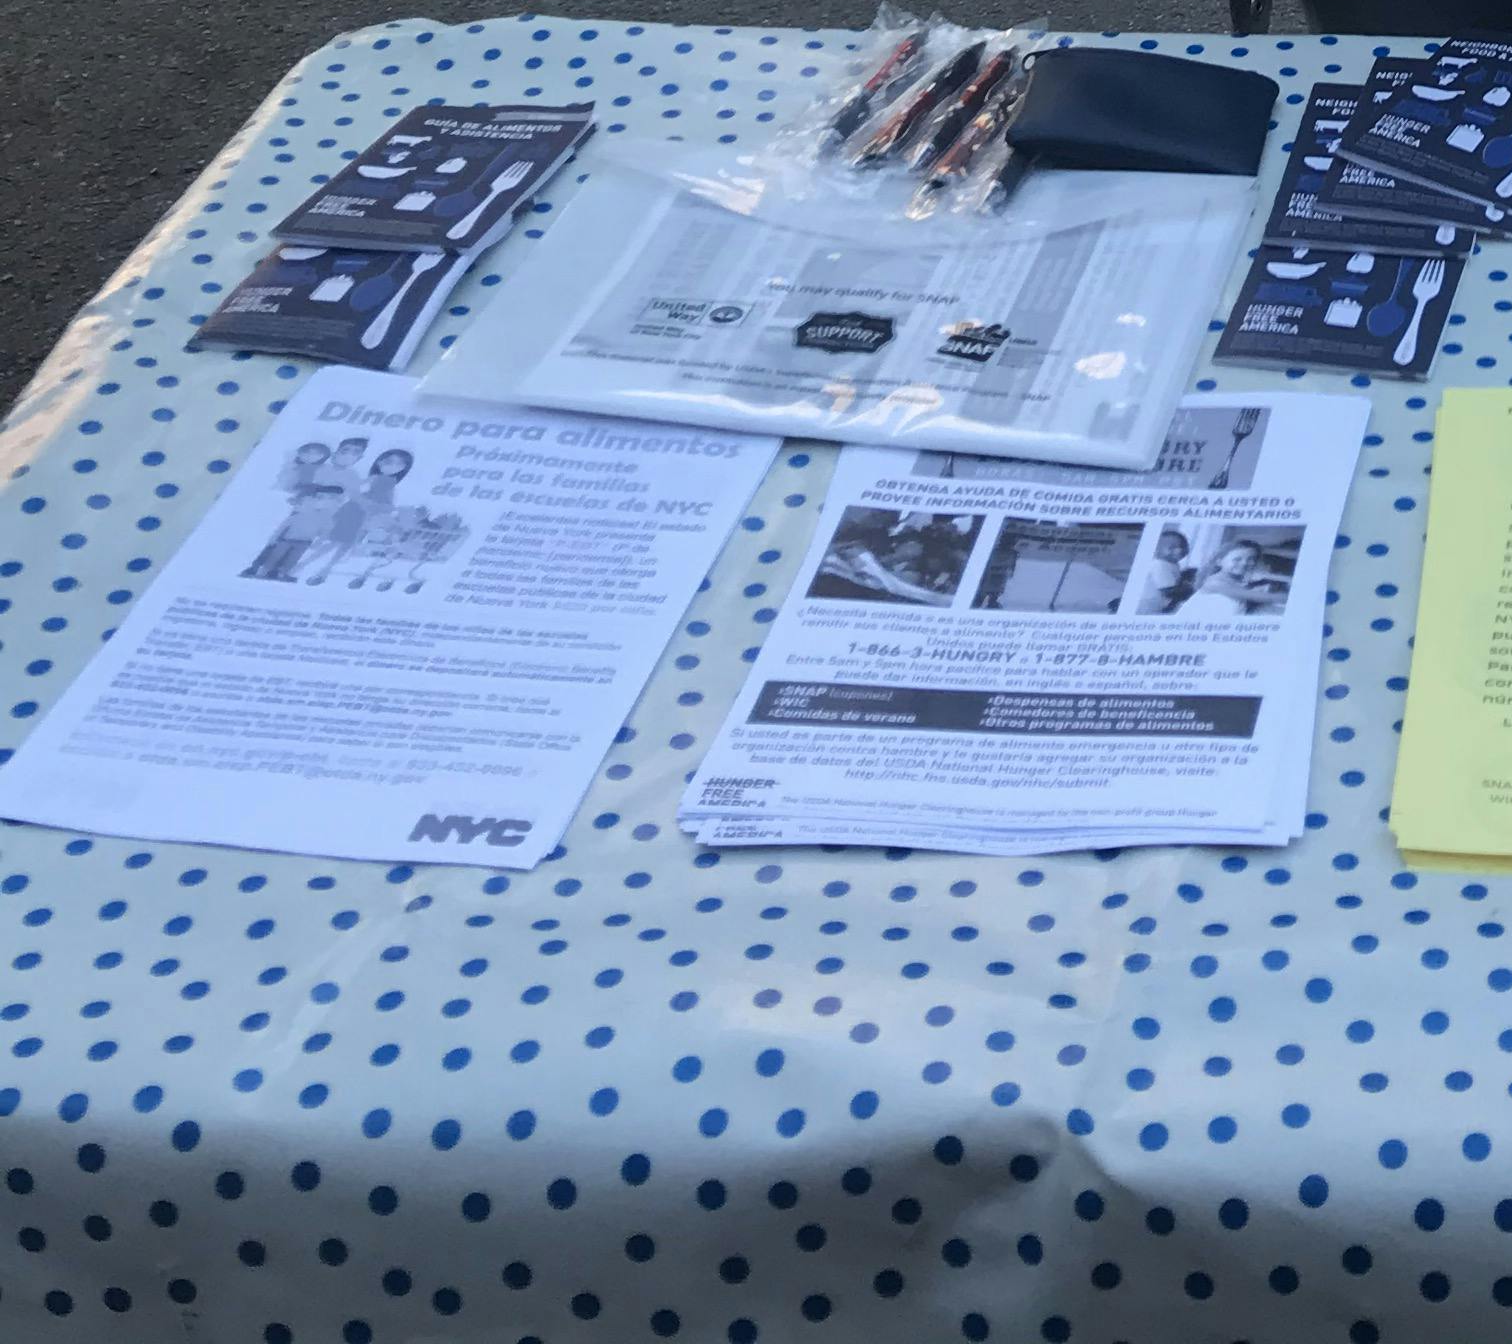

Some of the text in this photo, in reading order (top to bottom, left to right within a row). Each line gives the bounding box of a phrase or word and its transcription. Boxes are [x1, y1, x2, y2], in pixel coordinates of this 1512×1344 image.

[1462, 48, 1496, 57] FOOD
[1369, 127, 1421, 148] AMERICA
[1339, 176, 1395, 188] AMERICA
[1238, 322, 1298, 335] AMERICA
[317, 401, 743, 460] Dinero para alimentos
[442, 465, 651, 494] para las familias
[431, 481, 464, 497] de
[654, 499, 714, 518] NYC
[707, 777, 775, 790] HUNGER
[701, 788, 745, 800] FREE
[407, 814, 533, 847] NYC
